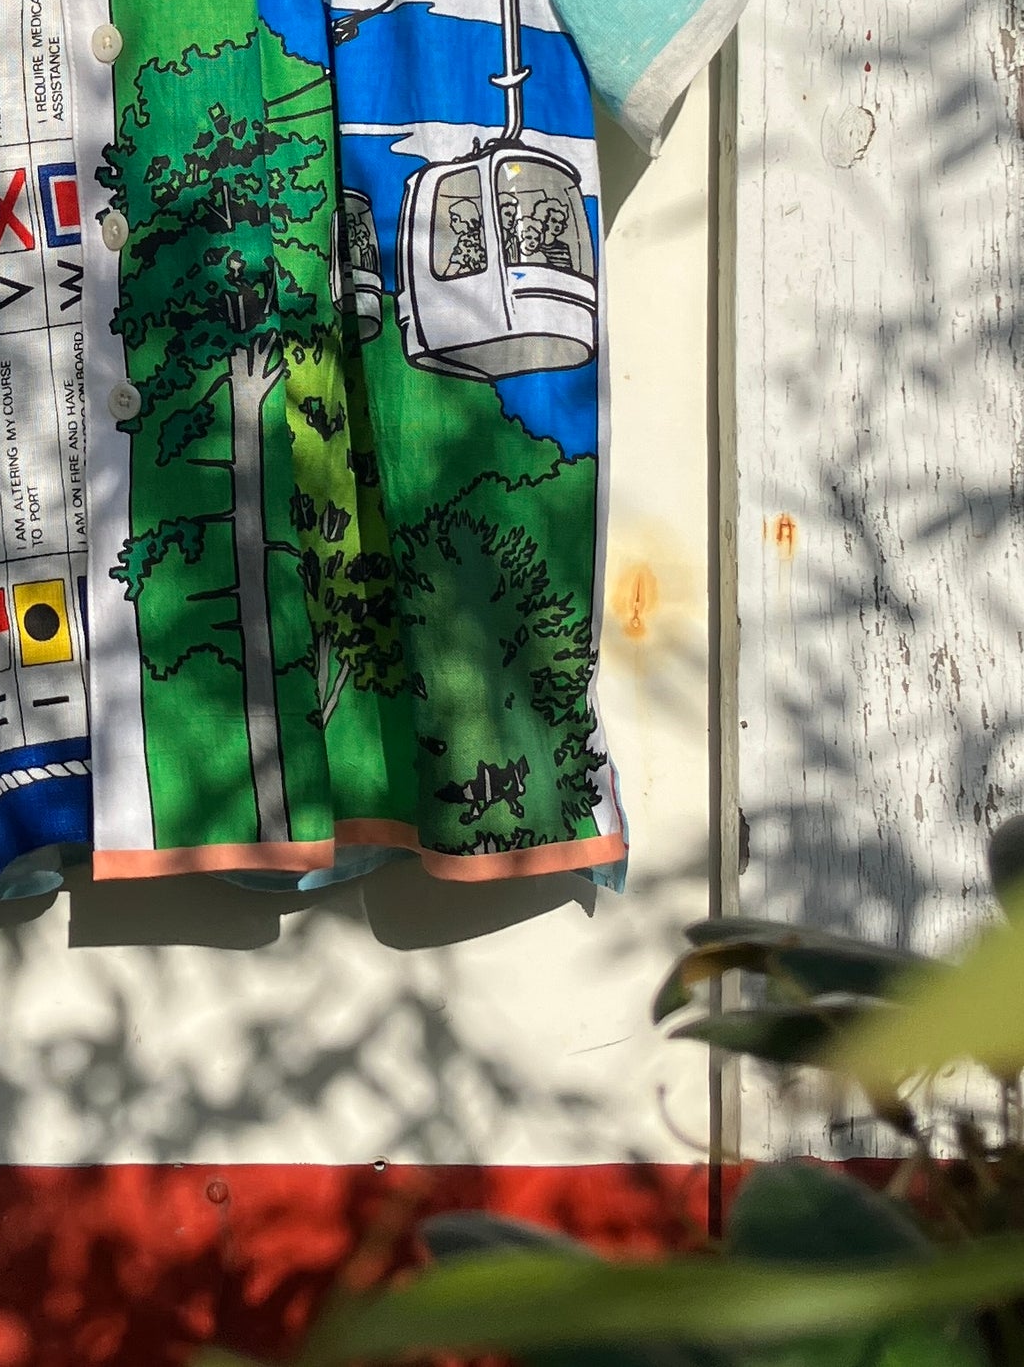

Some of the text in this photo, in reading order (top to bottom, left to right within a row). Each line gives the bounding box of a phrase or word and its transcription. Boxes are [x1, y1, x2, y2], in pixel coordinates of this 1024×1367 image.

[33, 54, 47, 112] REQUIRE
[49, 36, 64, 121] ASSISTANCE
[57, 260, 84, 311] W
[0, 360, 14, 415] COURSE
[64, 378, 76, 416] HAVE
[5, 419, 17, 441] MY
[68, 420, 79, 450] AND
[7, 447, 25, 511] ALTERING
[69, 454, 81, 483] FIRE
[72, 488, 83, 507] ON
[15, 518, 27, 541] AM
[27, 486, 43, 548] TO PORT
[74, 512, 86, 535] AM
[32, 695, 70, 707] I
